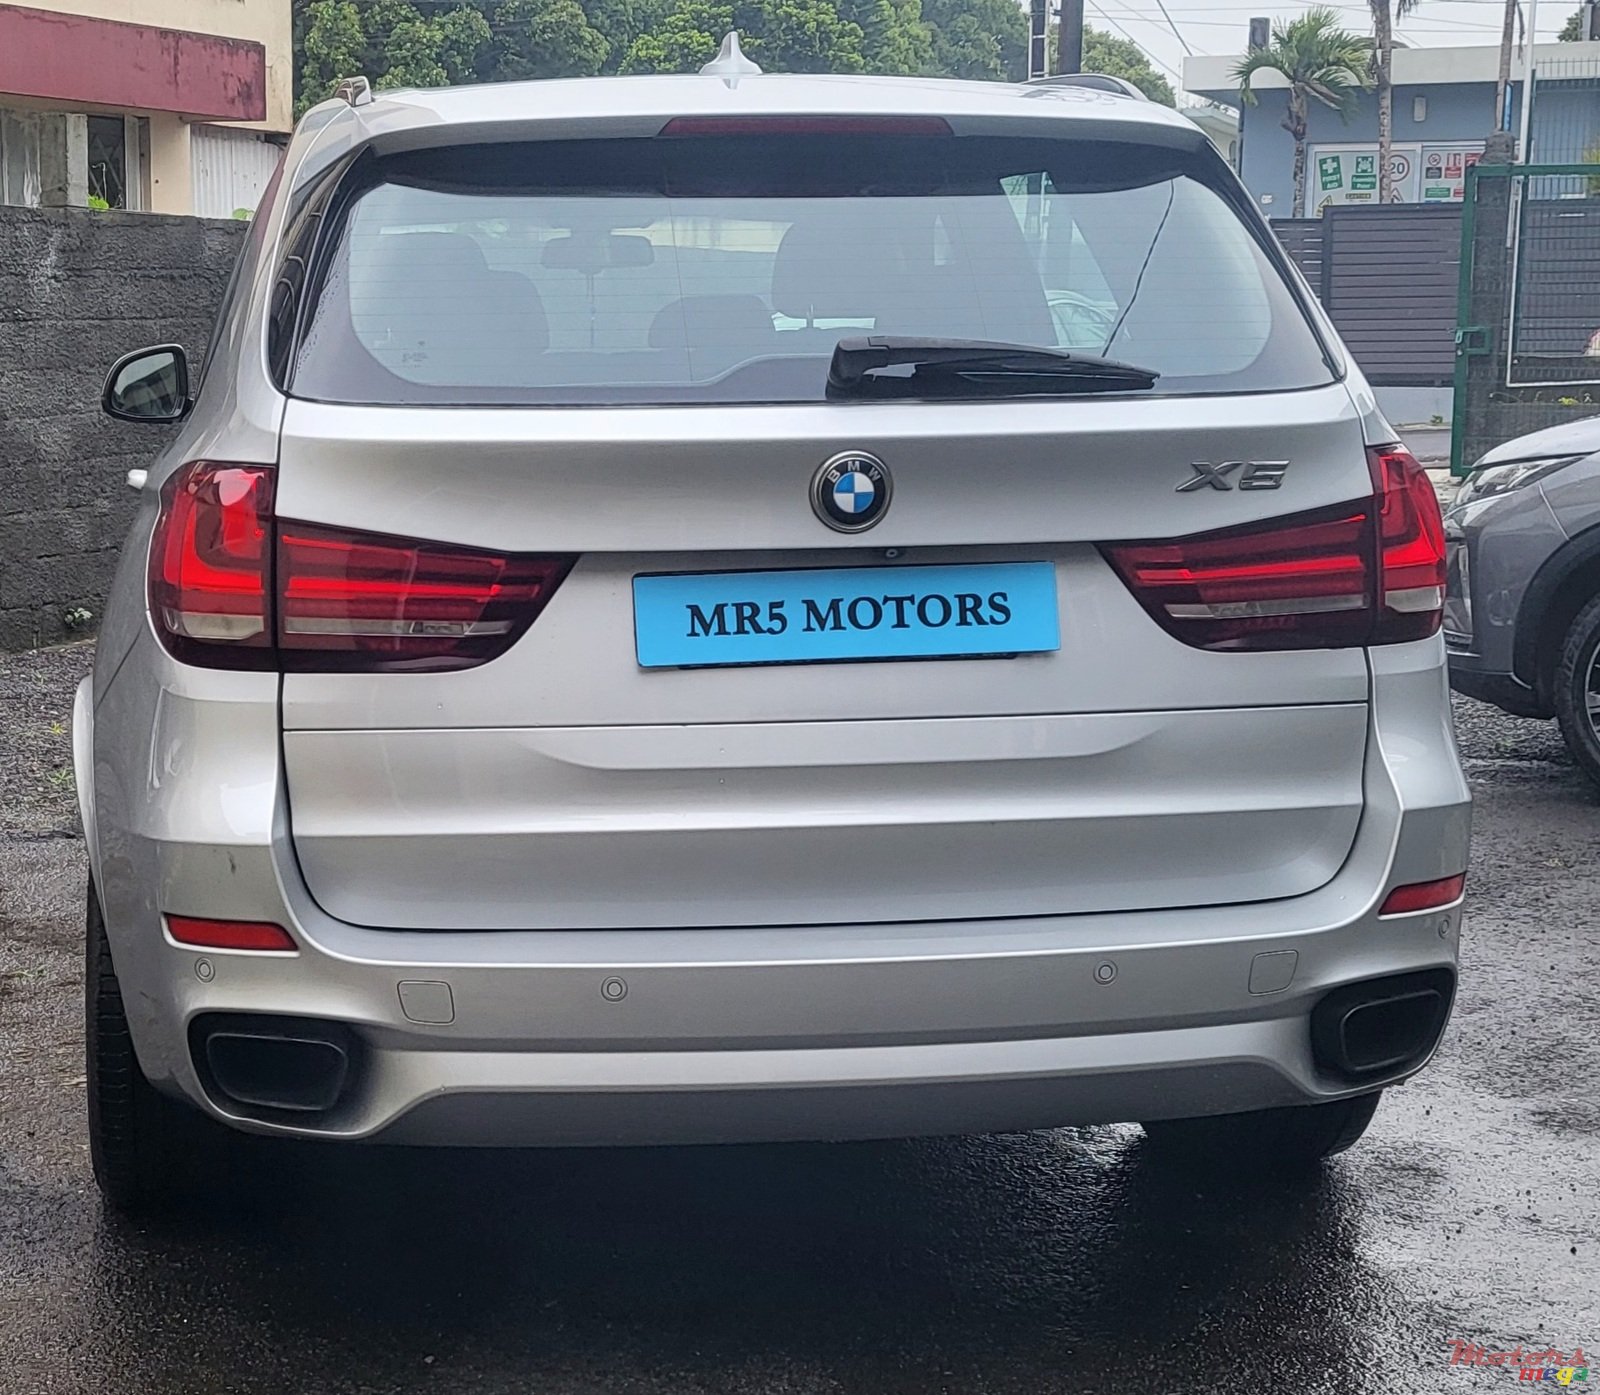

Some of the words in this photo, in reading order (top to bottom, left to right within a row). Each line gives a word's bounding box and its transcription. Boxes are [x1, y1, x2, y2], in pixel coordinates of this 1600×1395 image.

[827, 460, 881, 483] BMW
[1175, 460, 1290, 491] X5
[686, 600, 788, 637] MR5
[801, 592, 1012, 632] MOTORS
